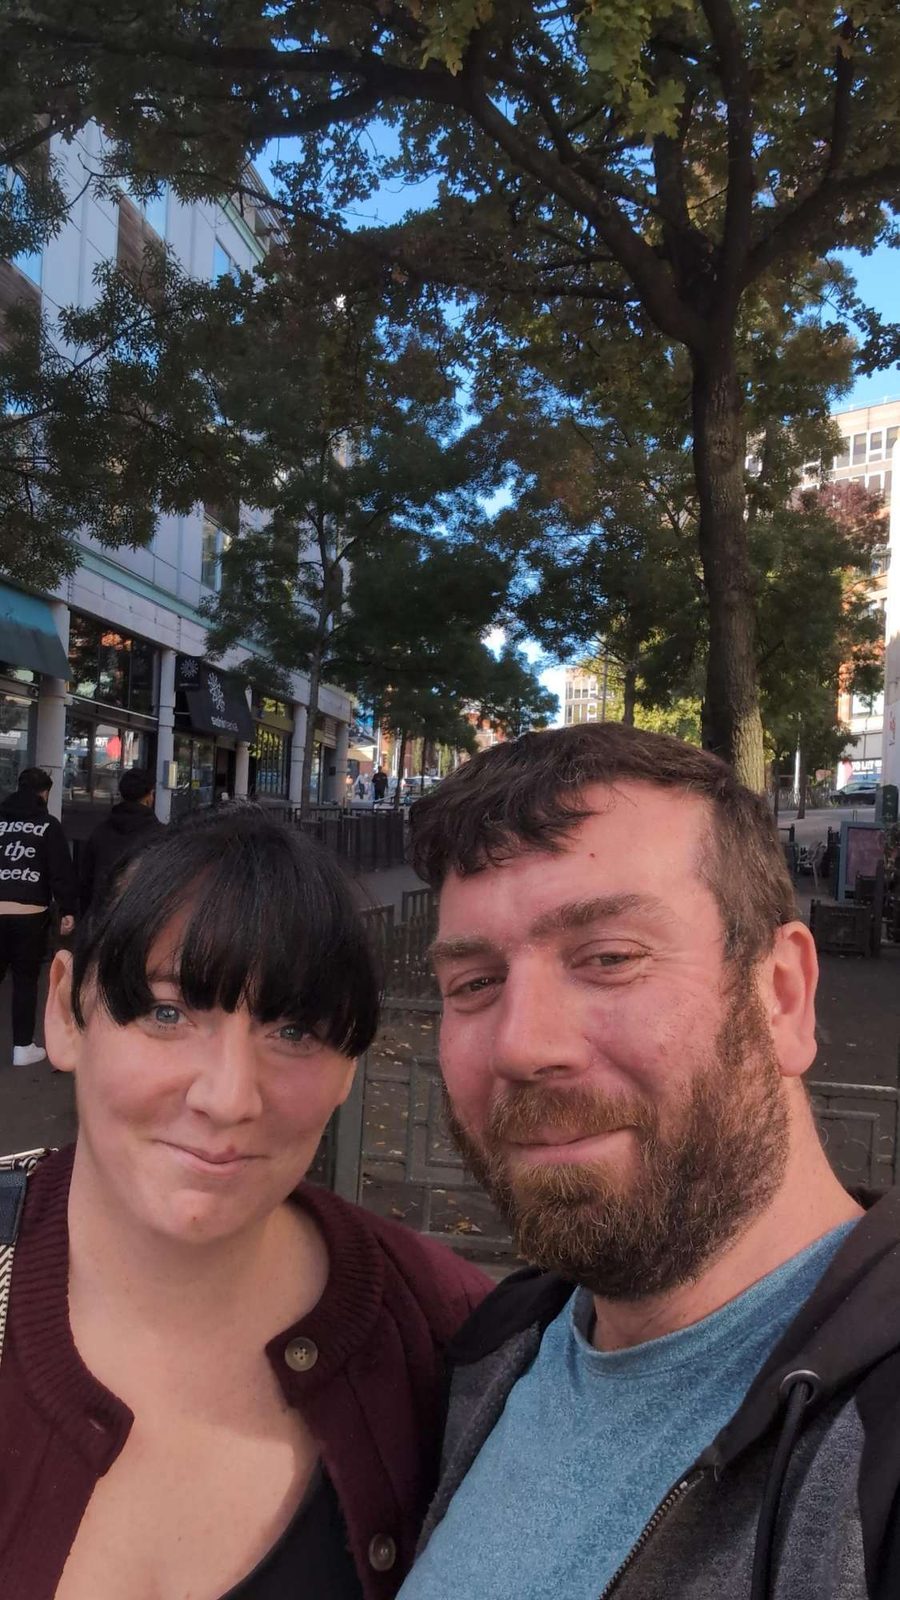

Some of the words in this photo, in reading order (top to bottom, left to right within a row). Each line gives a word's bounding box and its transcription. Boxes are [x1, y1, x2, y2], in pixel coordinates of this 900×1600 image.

[0, 821, 50, 837] aised
[4, 840, 36, 861] the
[0, 867, 41, 882] eets
